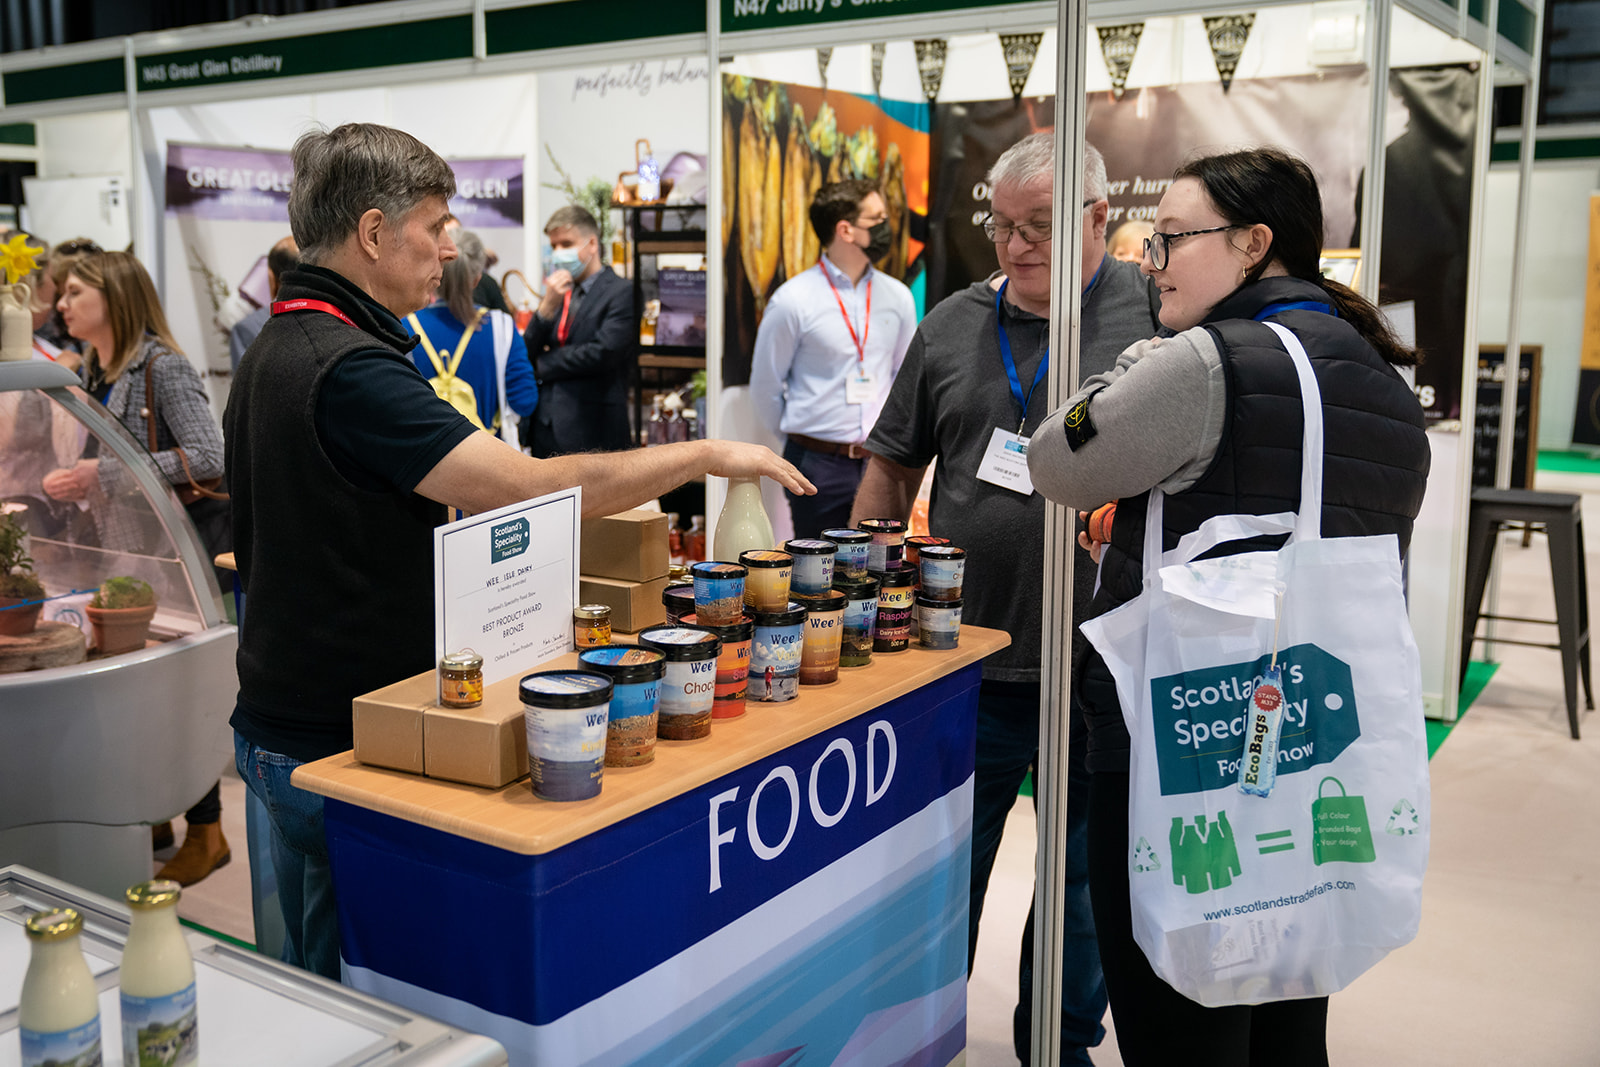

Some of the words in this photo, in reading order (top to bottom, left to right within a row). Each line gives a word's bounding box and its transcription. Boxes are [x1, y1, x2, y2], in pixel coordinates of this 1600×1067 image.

[734, 0, 769, 17] N47
[776, 0, 842, 13] Jaffys
[168, 62, 200, 81] Great
[202, 59, 229, 77] Glen
[231, 54, 283, 73] Distillery
[657, 58, 709, 86] balan
[186, 166, 253, 189] GREAT
[256, 170, 292, 192] GLE
[460, 178, 508, 199] GLEN
[495, 521, 522, 537] Scotland's
[495, 533, 522, 549] Speciality
[821, 557, 833, 565] We
[779, 570, 791, 578] We
[486, 577, 499, 588] WEE
[730, 582, 744, 590] We
[880, 592, 902, 602] Wee
[482, 621, 495, 633] BEST
[496, 611, 521, 628] PRODUCT
[523, 603, 542, 617] AWARD
[810, 618, 834, 628] Wee
[503, 623, 524, 638] BRONZE
[771, 634, 795, 645] Wee
[690, 661, 713, 674] Wee
[684, 680, 715, 695] Choc
[1171, 662, 1304, 711] Scotlan's
[1257, 692, 1279, 702] STAND
[1174, 699, 1308, 749] Specity
[1245, 714, 1269, 786] EcoBags
[1278, 742, 1314, 763] how
[709, 720, 898, 894] FOOD
[1329, 812, 1351, 820] Colour
[1318, 826, 1345, 834] Branded
[1345, 825, 1362, 834] Bags
